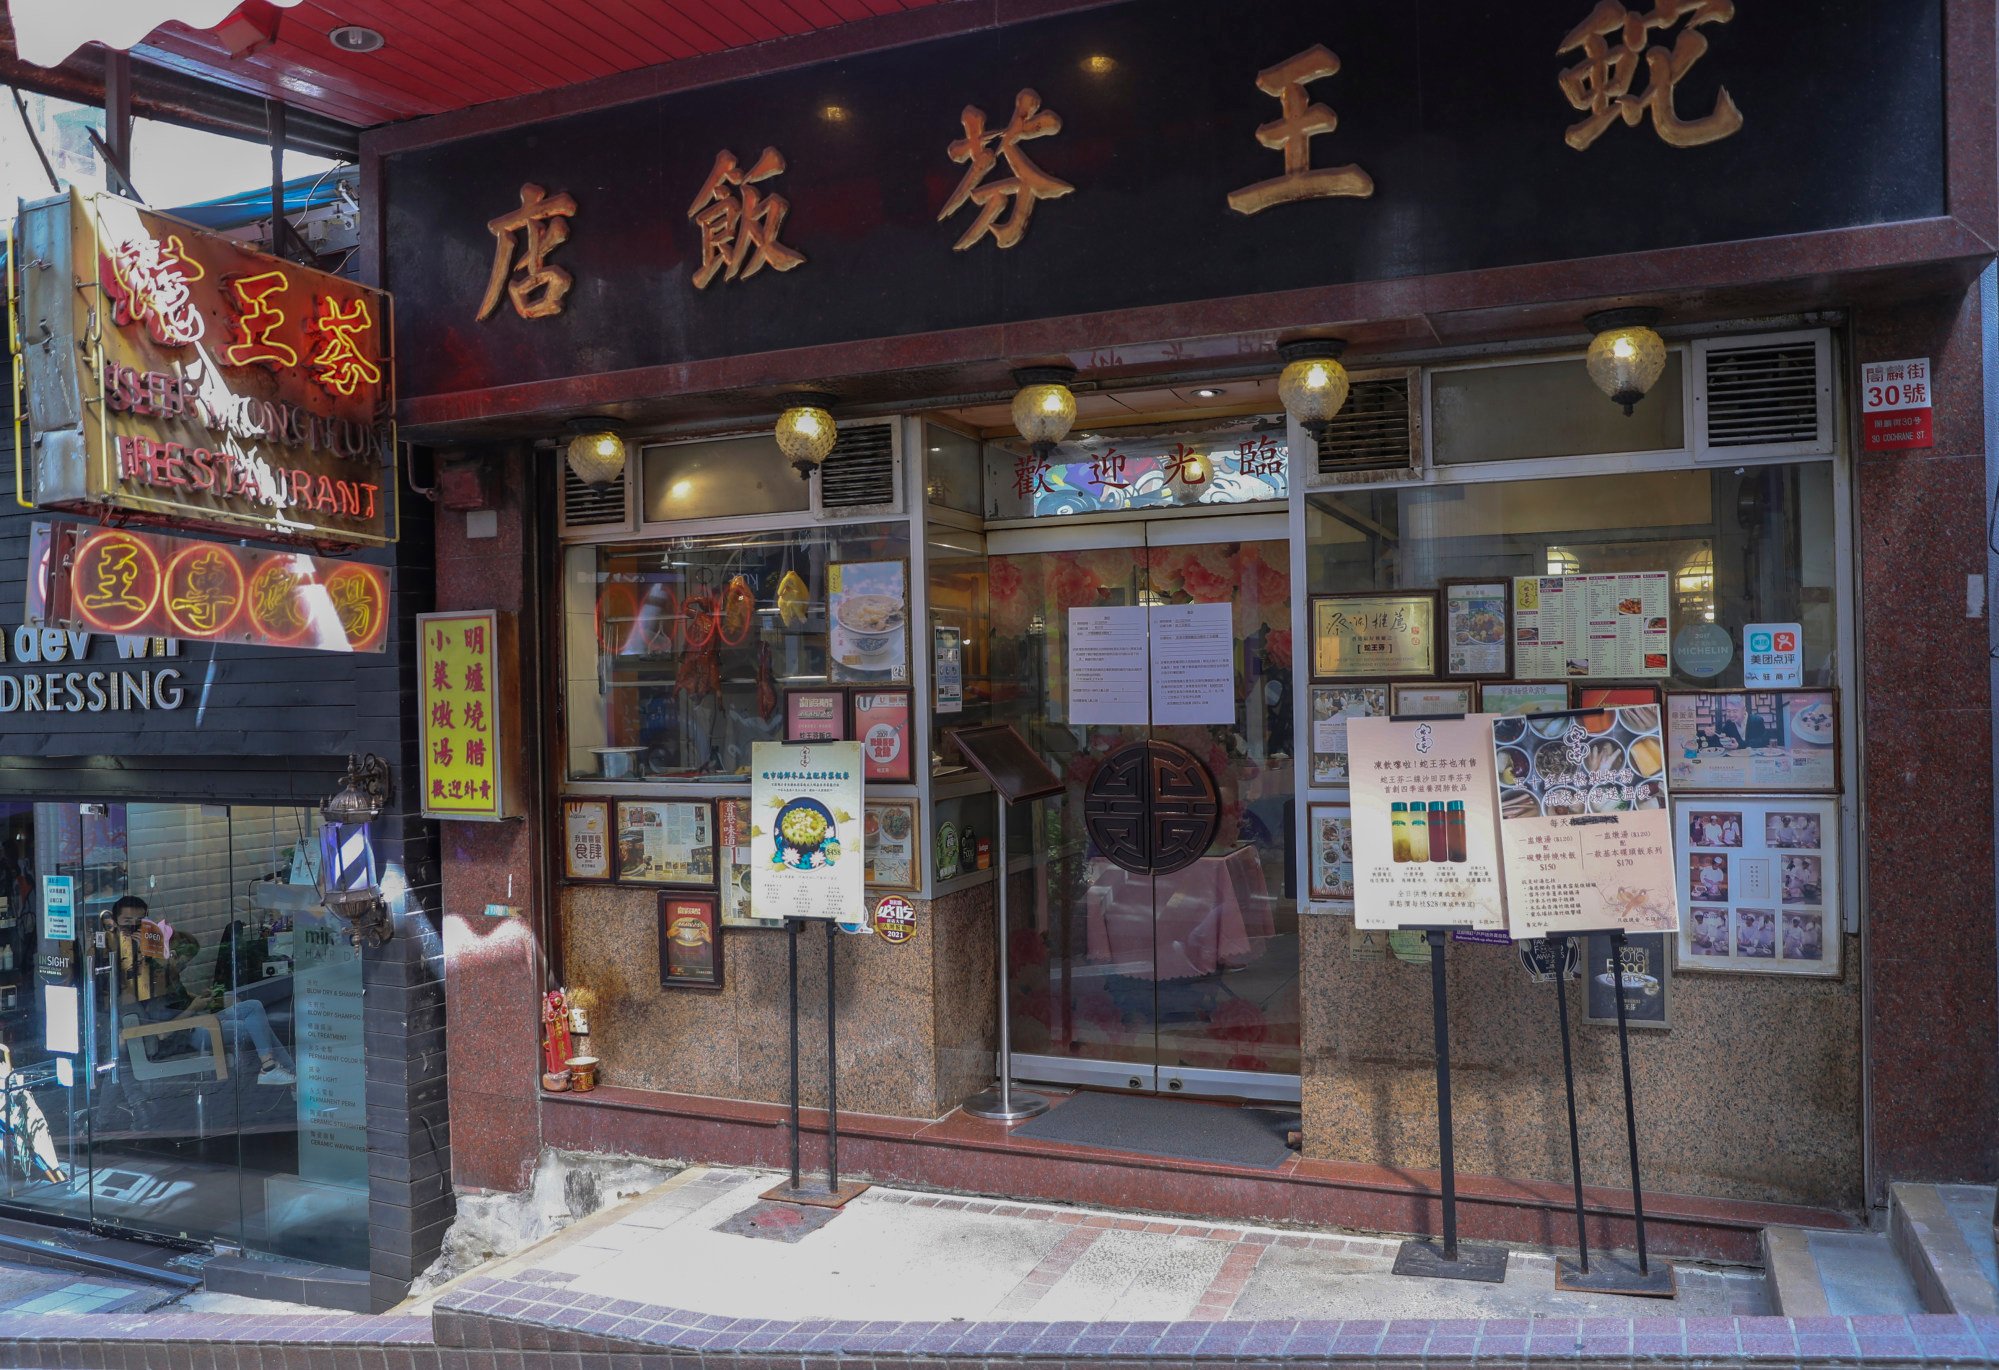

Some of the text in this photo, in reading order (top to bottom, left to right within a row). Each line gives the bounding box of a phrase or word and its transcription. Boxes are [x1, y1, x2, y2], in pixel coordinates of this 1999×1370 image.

[1866, 363, 1925, 383] 閣麟街
[1868, 383, 1926, 407] 30號
[1883, 431, 1914, 442] COCHRANE
[1007, 434, 1283, 499] 歡迎光臨
[116, 436, 380, 519] RESTAURANT
[1677, 646, 1729, 656] MICHELIN
[1750, 653, 1795, 665] 美团点评
[0, 668, 185, 713] DRESSING
[430, 629, 456, 768] 小菜燉湯
[431, 778, 491, 800] 歡迎外賣
[723, 801, 737, 847] 香港味道
[1539, 863, 1557, 871] $150
[1616, 859, 1634, 867] $170
[877, 905, 916, 921] 必吃
[144, 930, 162, 943] OPEN
[887, 931, 903, 939] 2021
[38, 955, 70, 968] INSIGHT
